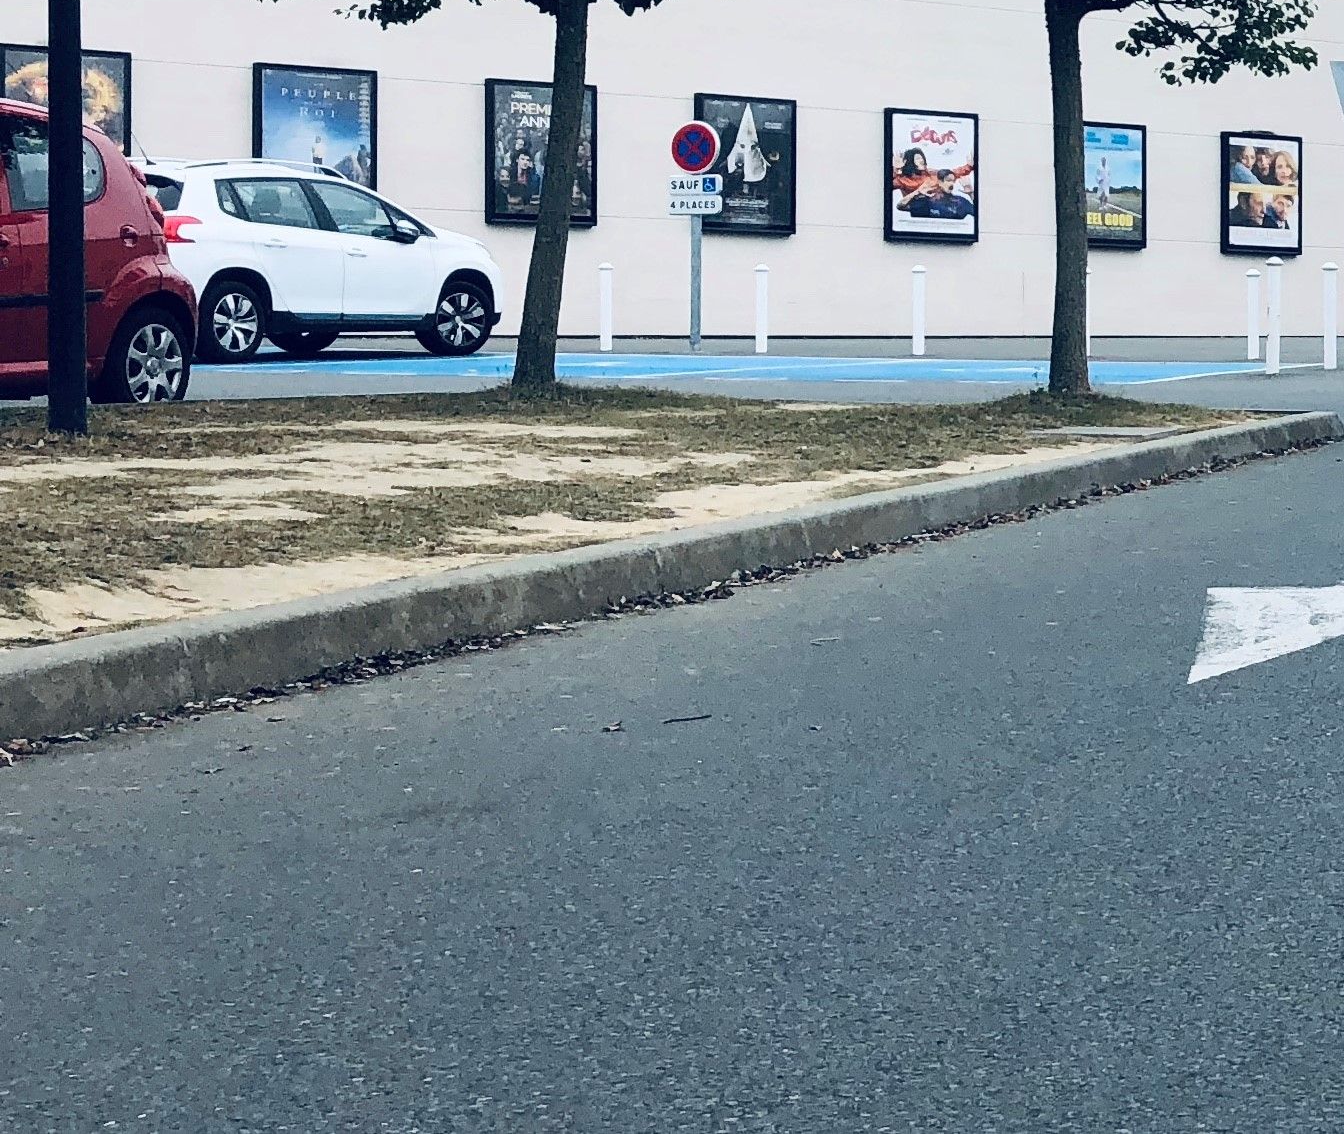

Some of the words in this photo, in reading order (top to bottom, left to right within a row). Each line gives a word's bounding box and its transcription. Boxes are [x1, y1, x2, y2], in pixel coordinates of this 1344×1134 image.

[510, 101, 552, 116] PREMI
[519, 115, 551, 129] ANN
[670, 179, 700, 190] SAUF
[670, 200, 676, 209] 4
[680, 200, 716, 209] PLACES
